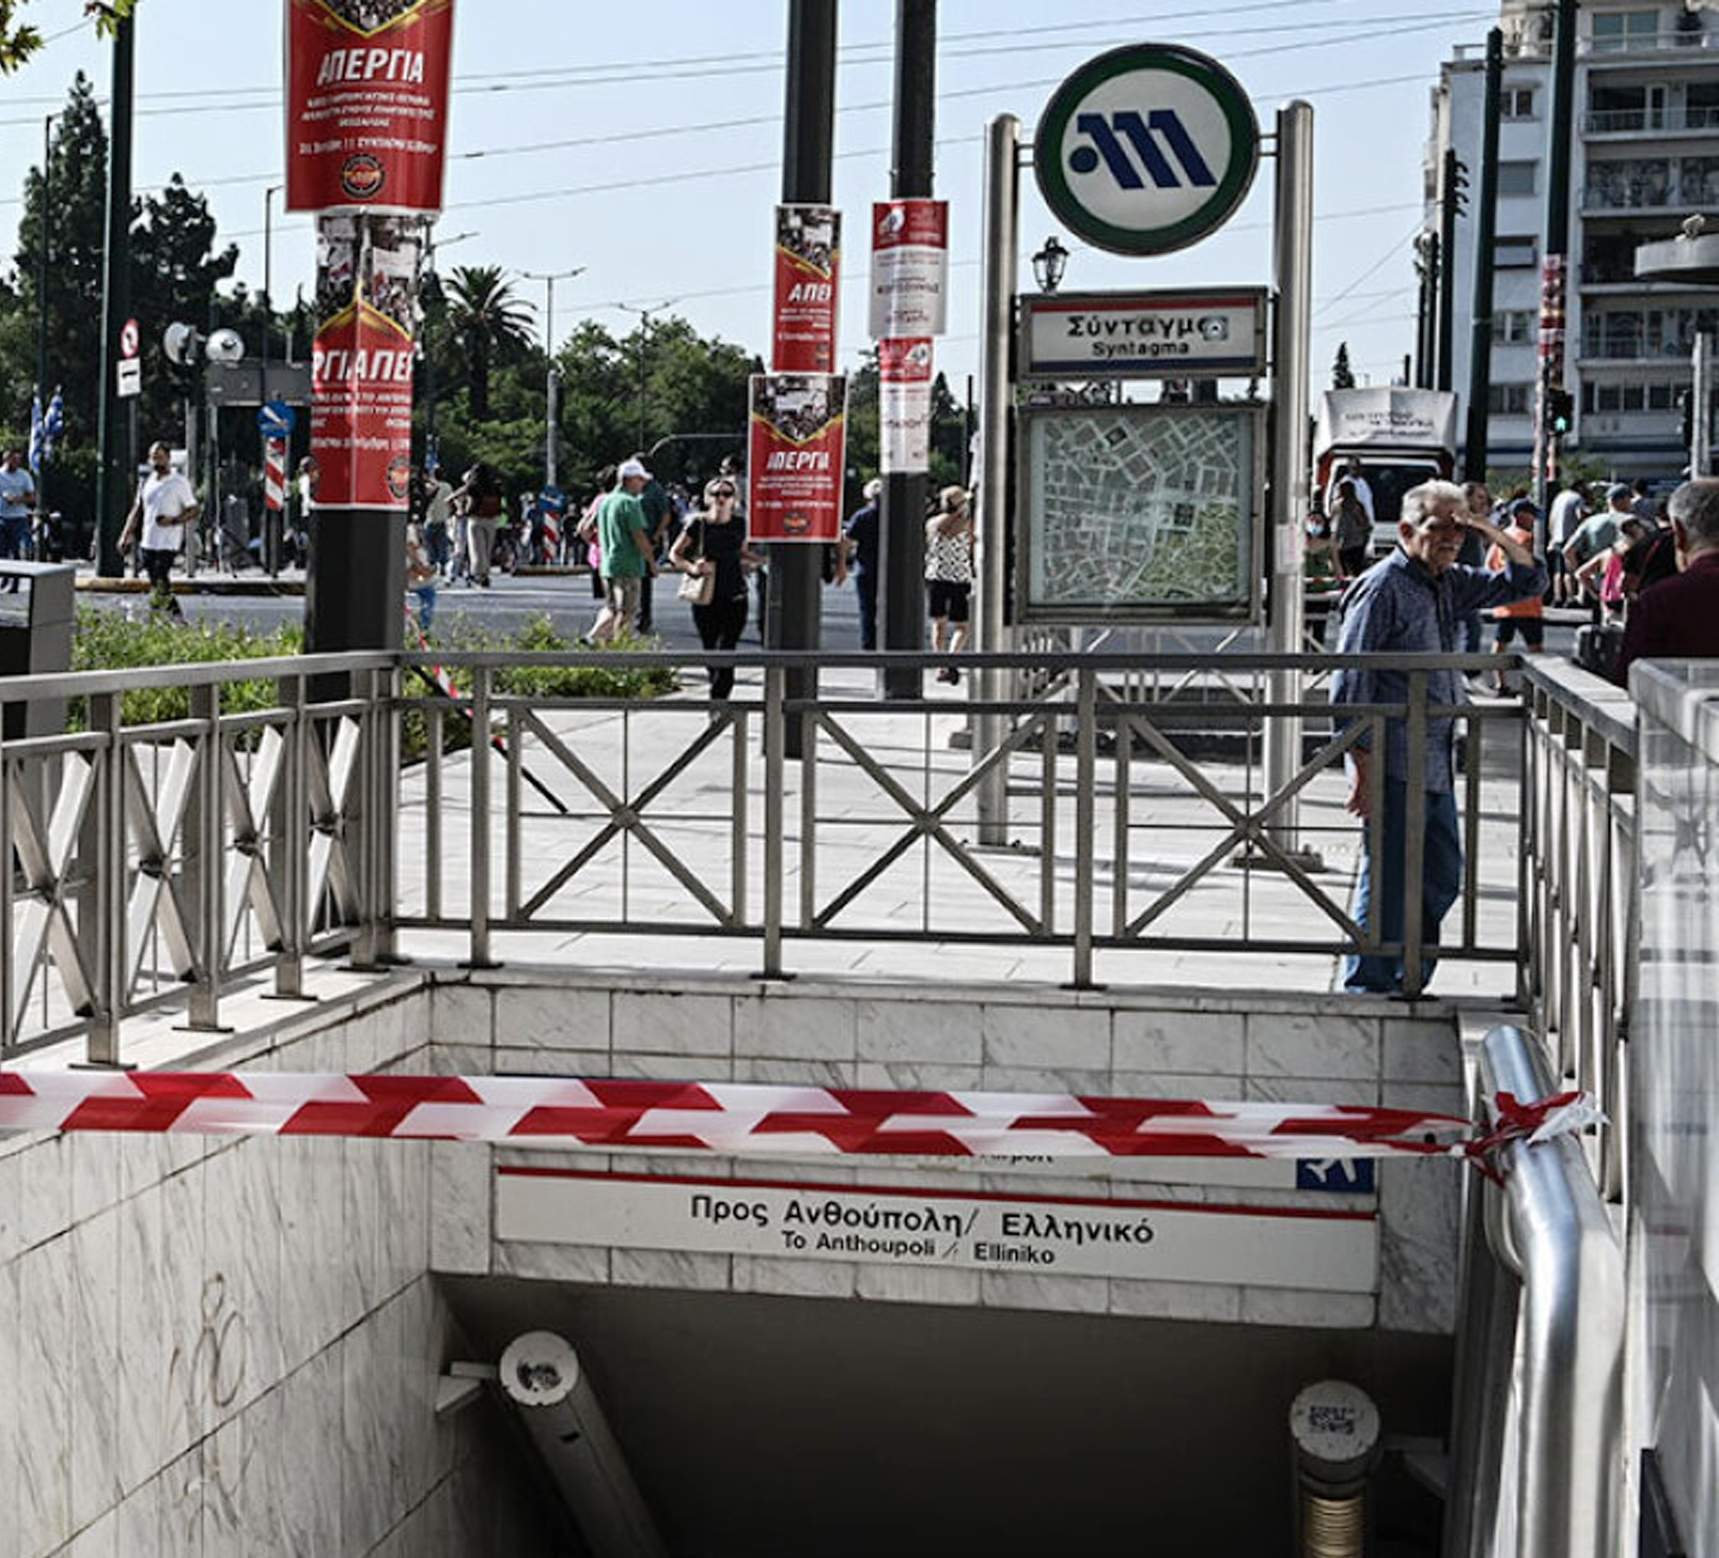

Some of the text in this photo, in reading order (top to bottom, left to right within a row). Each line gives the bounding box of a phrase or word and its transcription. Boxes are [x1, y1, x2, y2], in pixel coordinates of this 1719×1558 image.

[316, 49, 425, 87] ΑΠΕΡΓΙΑ
[1092, 339, 1191, 359] Syntagma
[690, 1194, 769, 1228] Προς
[1001, 1212, 1155, 1246] Ελληνικό
[781, 1229, 807, 1250] To
[815, 1231, 936, 1259] Anthoupoli
[973, 1241, 1056, 1265] Elliniko
